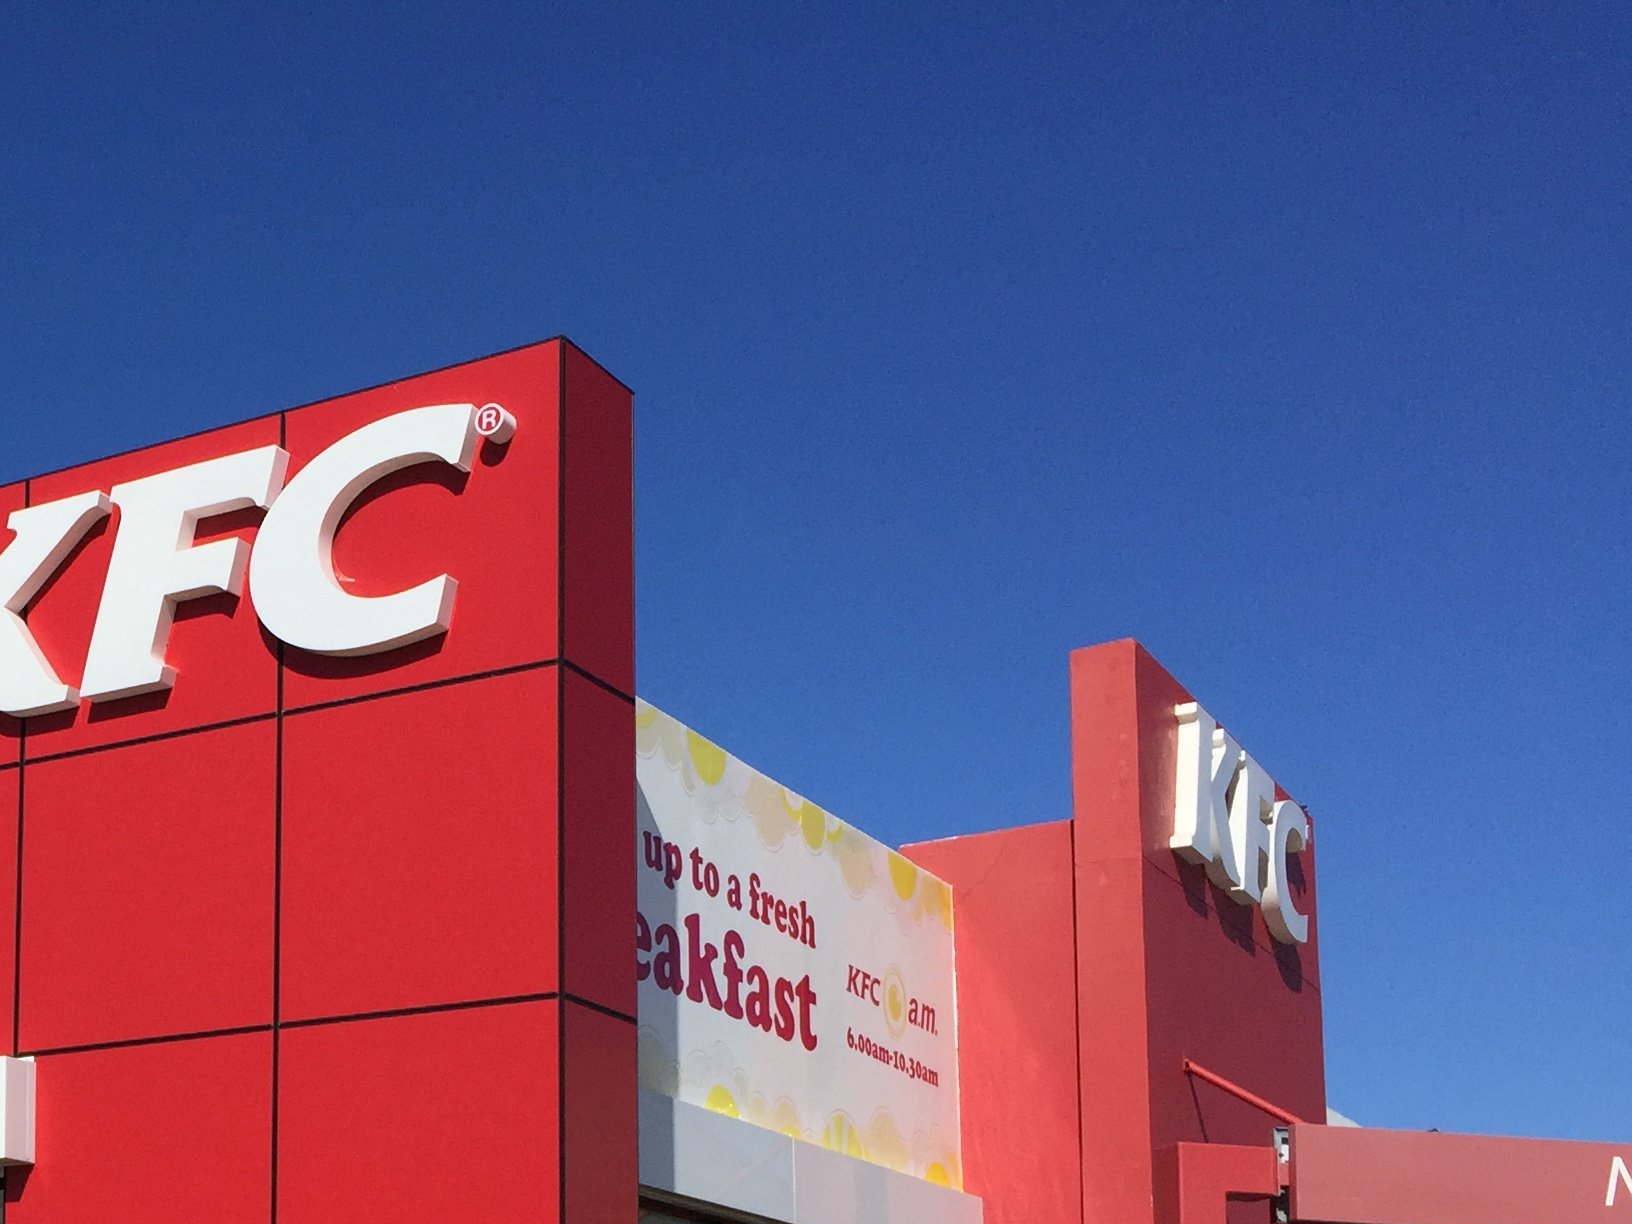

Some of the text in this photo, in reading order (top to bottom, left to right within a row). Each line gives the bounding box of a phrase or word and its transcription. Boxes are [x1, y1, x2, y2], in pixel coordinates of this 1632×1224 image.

[1169, 701, 1308, 943] KFC
[643, 830, 816, 949] up to a fresh
[846, 964, 938, 1036] KFC a.m.
[847, 1027, 939, 1087] 6.00am-10.30am
